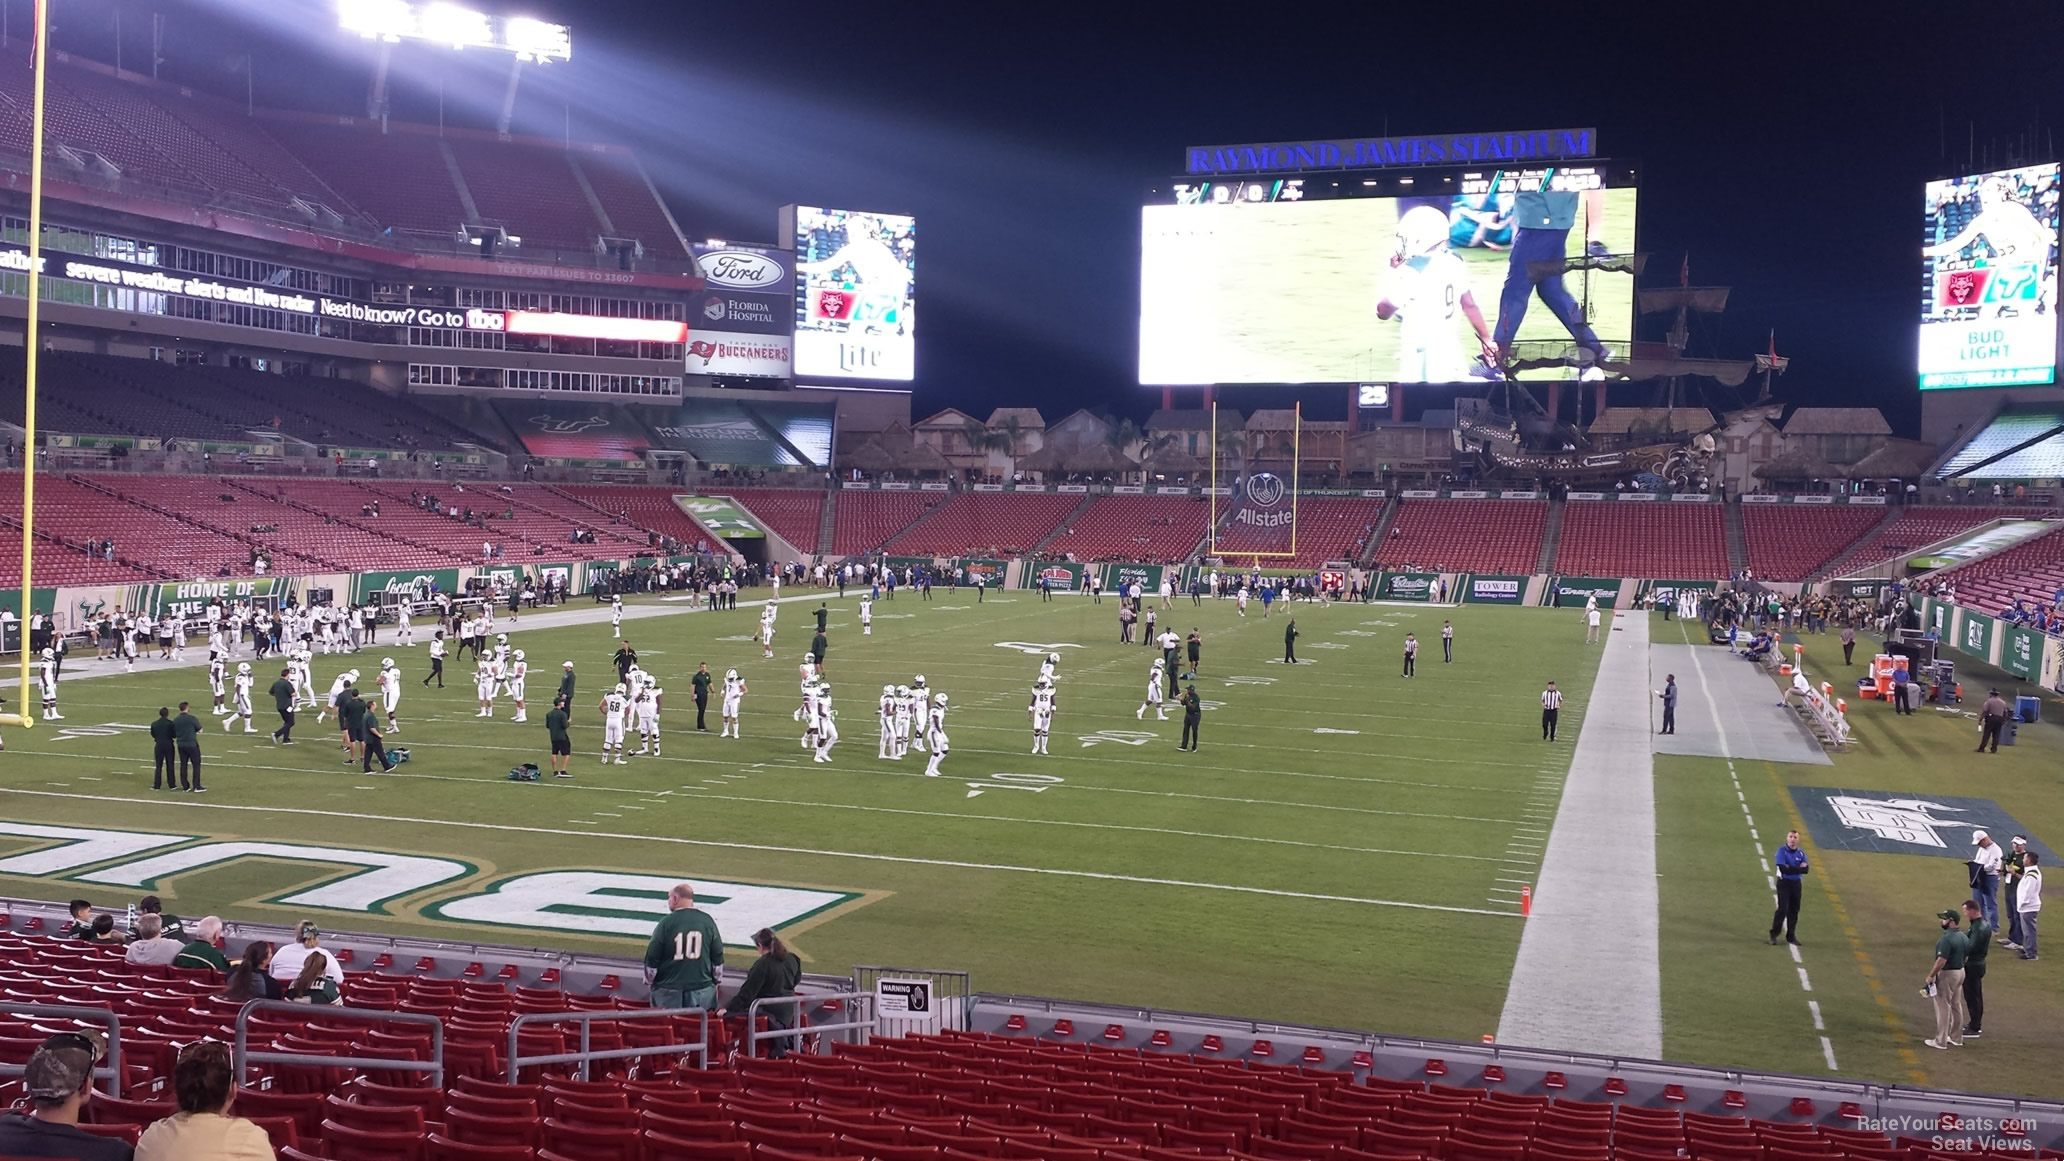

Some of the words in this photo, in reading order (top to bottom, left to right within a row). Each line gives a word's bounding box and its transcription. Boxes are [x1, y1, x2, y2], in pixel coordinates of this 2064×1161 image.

[1190, 144, 1339, 172] RAYMOND
[1344, 137, 1445, 166] JAMES
[1452, 131, 1591, 160] STADIUM
[498, 266, 523, 276] TEXT
[526, 268, 547, 278] FAN
[549, 269, 585, 280] ISSUES
[588, 272, 601, 281] TO
[604, 273, 634, 284] 33607
[712, 256, 766, 282] Ford
[66, 261, 120, 284] severe
[122, 270, 184, 293] weather
[185, 278, 226, 301] alerts
[226, 285, 253, 304] and
[253, 288, 280, 307] live
[320, 298, 350, 317] Need
[351, 303, 363, 319] to
[363, 301, 413, 324] know?
[418, 307, 446, 327] Go
[448, 311, 464, 327] to
[728, 300, 769, 312] FLORIDA
[728, 310, 774, 322] HOSPITAL
[1968, 330, 2005, 345] BUD
[718, 343, 788, 362] BUCCANEERS
[839, 343, 882, 372] Lite
[1960, 345, 2011, 361] LIGHT
[1358, 385, 1388, 405] 25
[1235, 507, 1293, 527] Allstate
[177, 583, 229, 598] HOME
[236, 582, 255, 596] OF
[1475, 582, 1517, 591] TOWER
[168, 601, 203, 617] THE
[634, 675, 643, 684] 10
[1040, 694, 1049, 702] 85
[609, 701, 621, 713] 68
[672, 930, 703, 960] 10
[882, 983, 911, 993] WARNING
